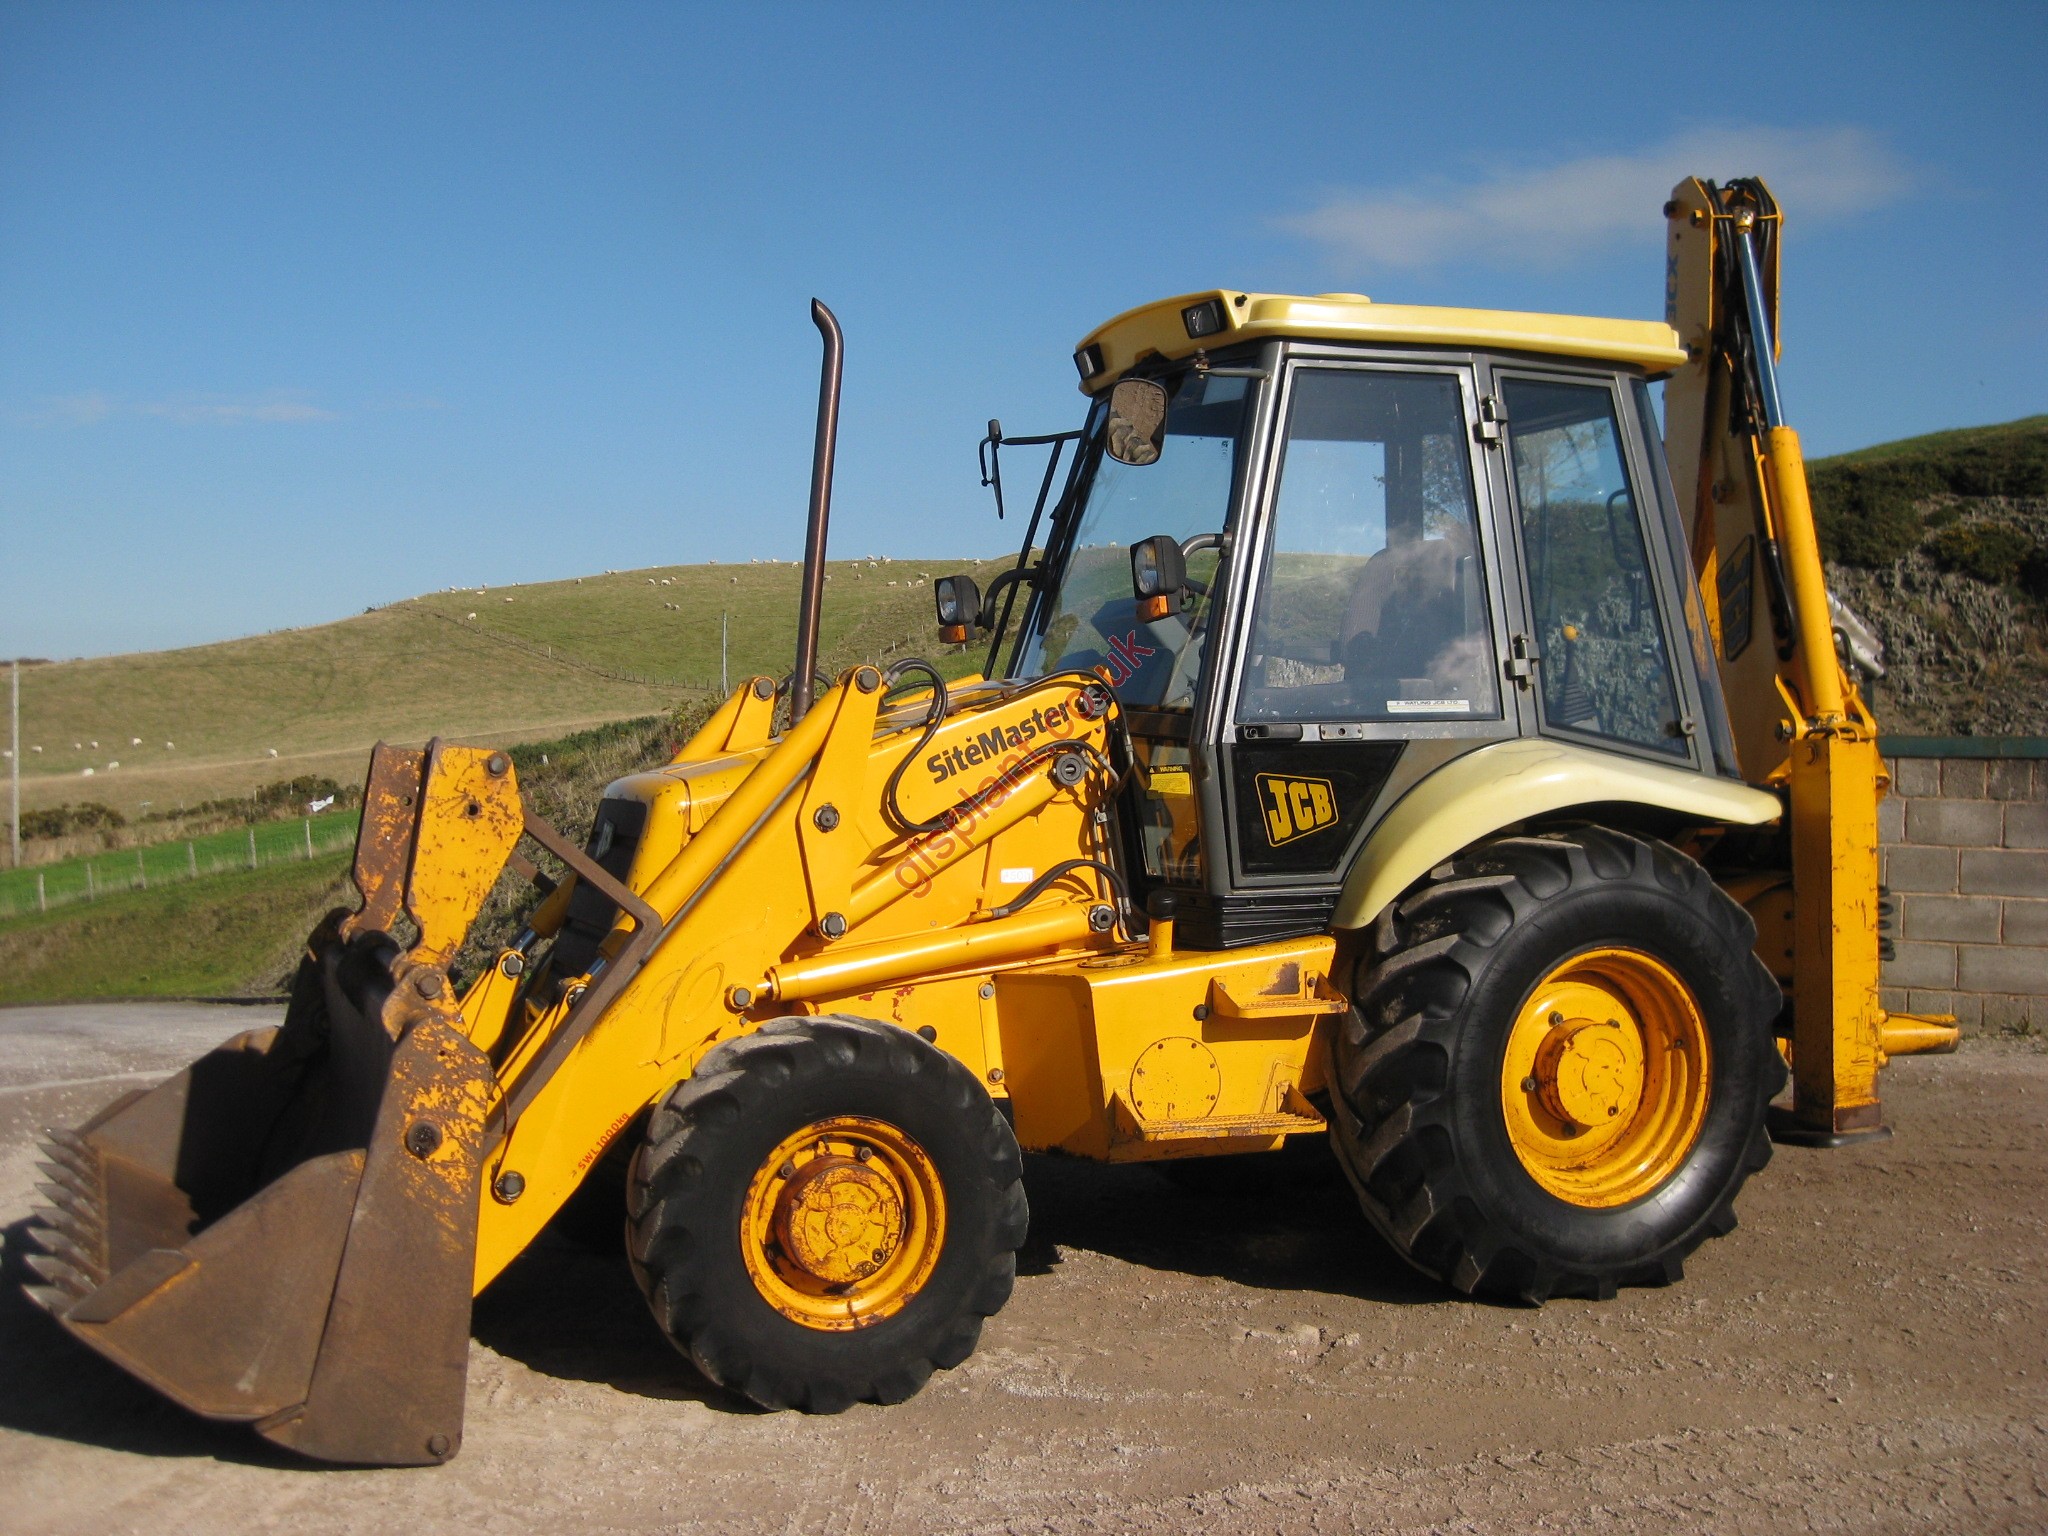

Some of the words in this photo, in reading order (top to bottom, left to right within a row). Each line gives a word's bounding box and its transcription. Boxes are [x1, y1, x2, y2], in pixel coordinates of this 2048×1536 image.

[927, 699, 1071, 784] SiteMaster
[1268, 779, 1332, 841] JCB
[578, 1149, 599, 1170] SWL
[596, 1113, 630, 1149] 1000kg
